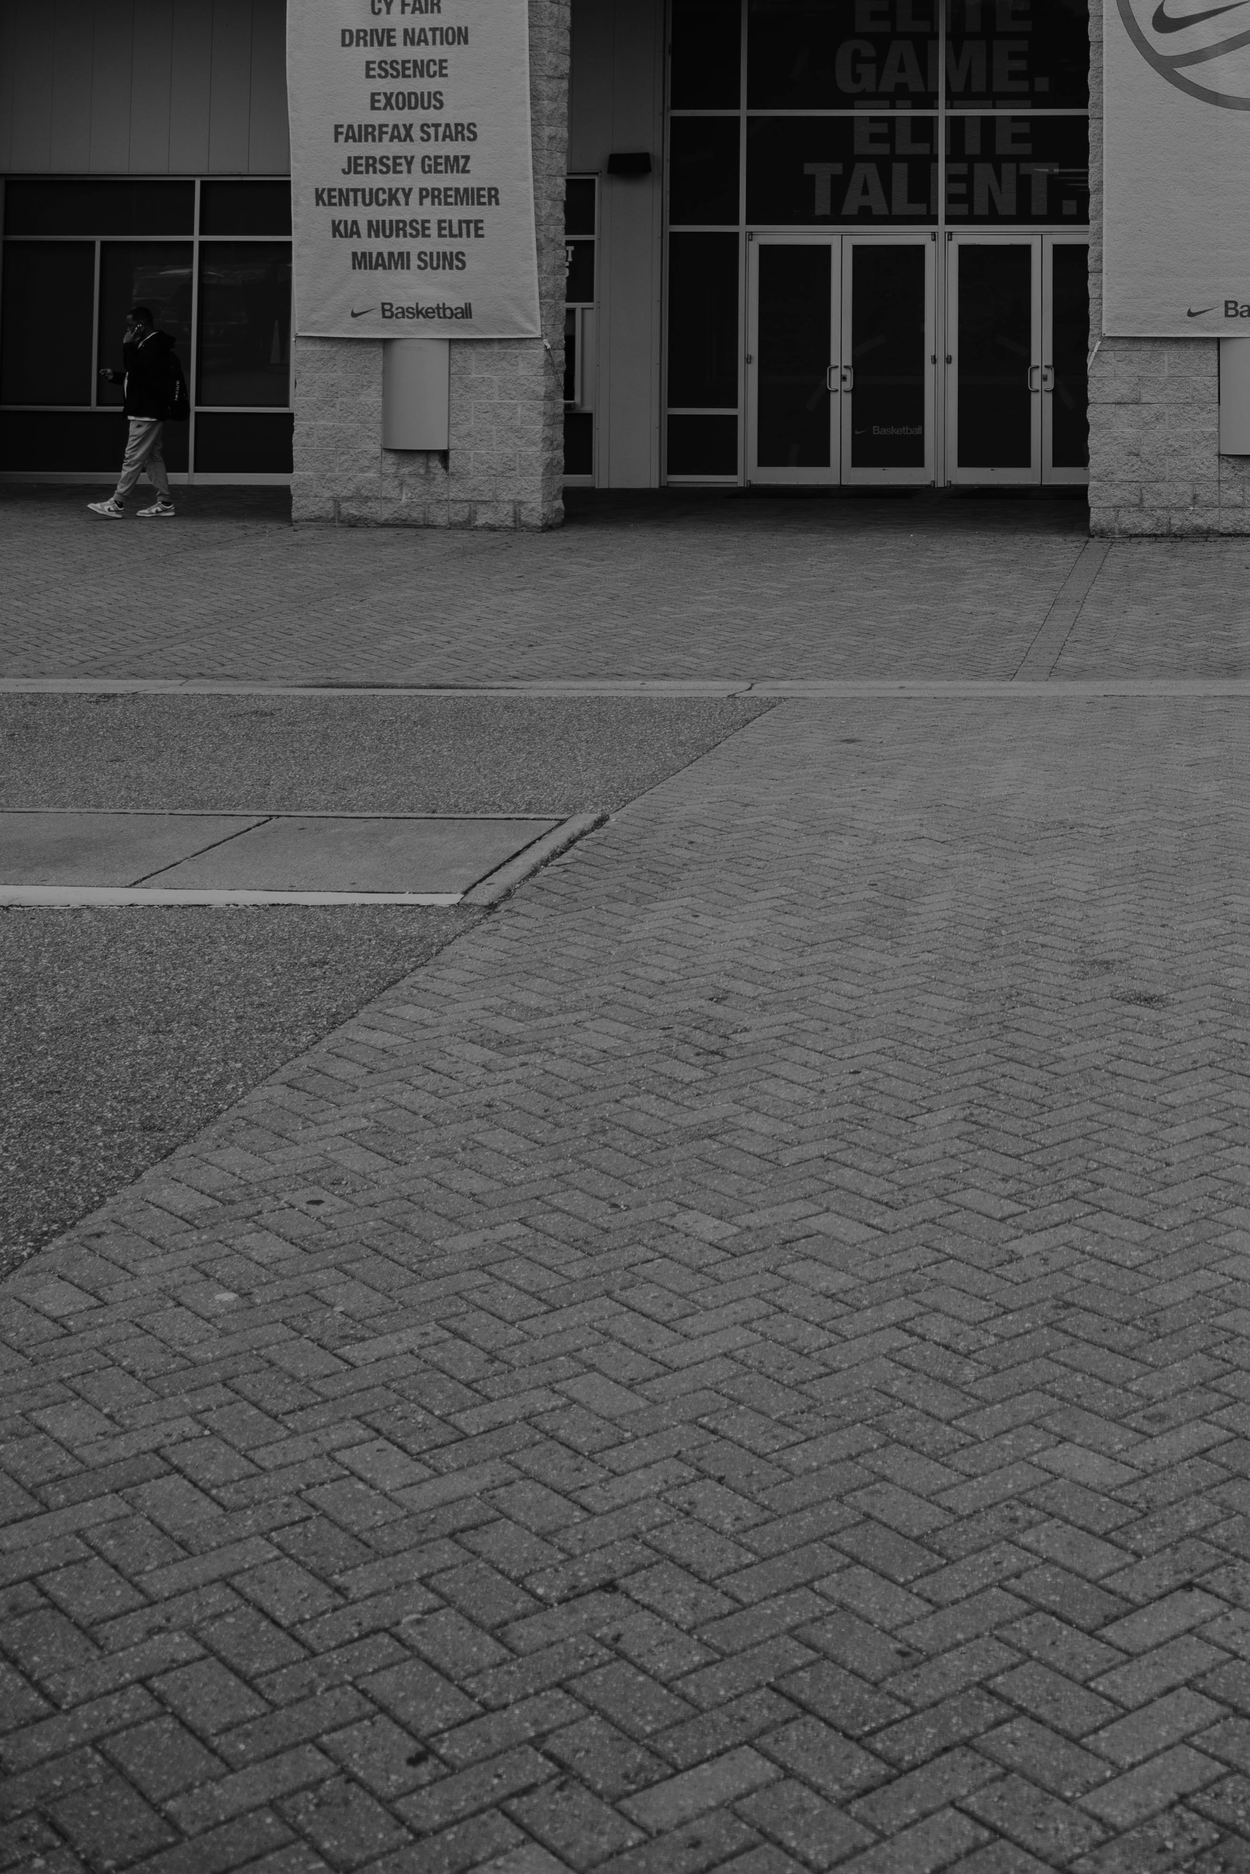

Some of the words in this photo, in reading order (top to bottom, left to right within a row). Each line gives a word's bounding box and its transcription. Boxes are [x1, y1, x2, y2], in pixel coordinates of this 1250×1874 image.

[341, 28, 396, 47] DRIVE
[403, 26, 468, 46] NATION
[365, 59, 448, 79] ESSENCE
[835, 40, 1049, 93] GAME.
[370, 91, 444, 110] EXODUS
[334, 124, 414, 143] FAIRFAX
[420, 123, 477, 142] STARS
[854, 100, 1032, 155] ELITE
[341, 156, 415, 175] JERSEY
[421, 155, 470, 174] GEMZ
[315, 188, 413, 207] KENTUCKY
[419, 187, 500, 206] PREMIER
[803, 163, 1077, 215] TALENT.
[332, 220, 361, 238] KIA
[367, 219, 431, 238] NURSE
[437, 219, 484, 238] ELITE
[352, 252, 410, 270] MIAMI
[417, 251, 466, 270] SUNS
[381, 302, 472, 319] Basketball
[873, 426, 922, 435] Basketball
